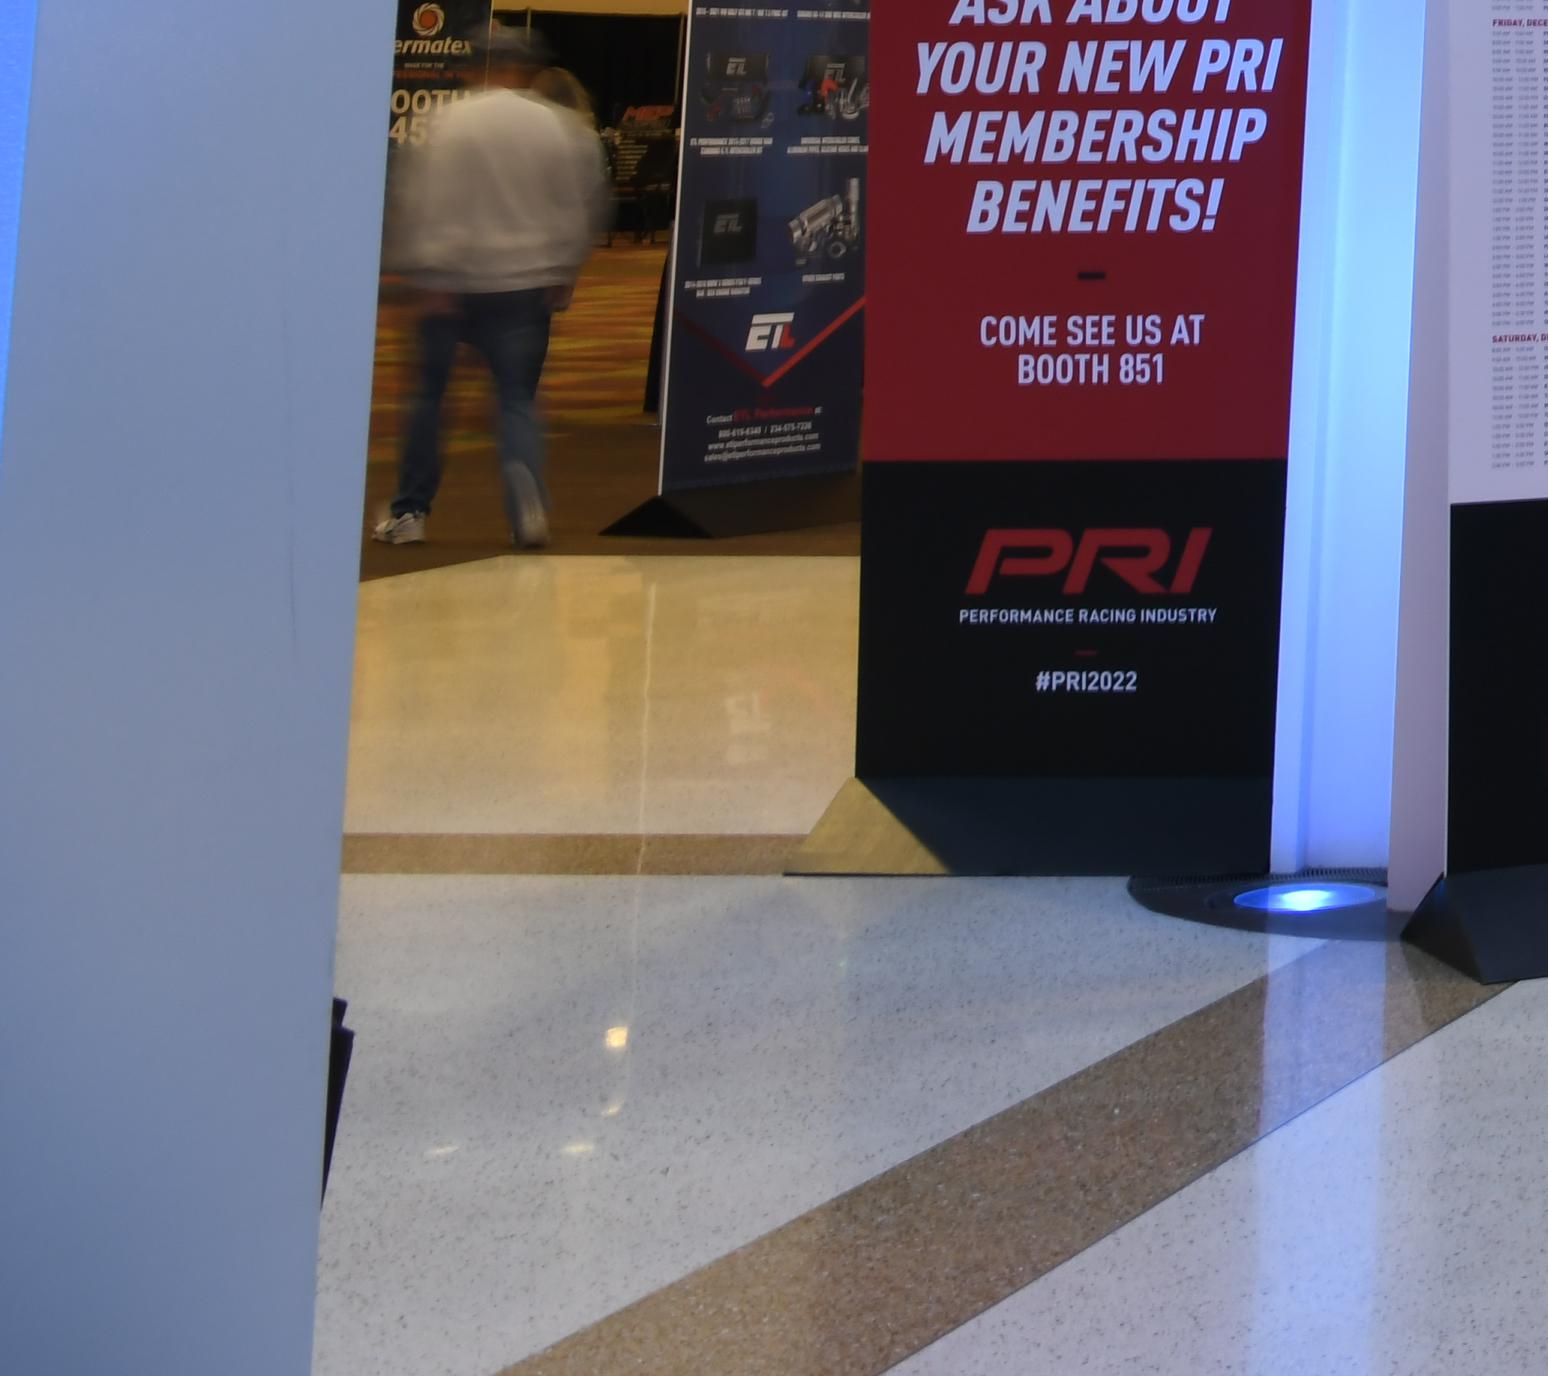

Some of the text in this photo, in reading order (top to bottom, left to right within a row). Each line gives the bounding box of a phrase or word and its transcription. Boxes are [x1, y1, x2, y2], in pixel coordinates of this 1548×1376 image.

[1492, 18, 1525, 29] FRIDAY,
[395, 36, 473, 56] ermatex
[914, 37, 1284, 95] YOUR NEW PRI
[924, 107, 1268, 165] MEMBERSHIP
[966, 177, 1225, 234] BENEFITS!
[980, 313, 1206, 347] COME SEE US AT
[1492, 333, 1540, 344] SATURDAY,
[1017, 352, 1165, 386] BOOTH 851
[964, 527, 1213, 596] PRI
[959, 606, 1218, 625] PERFORMANCE RACING INDUSTRY
[1035, 669, 1138, 694] #PRI2022
